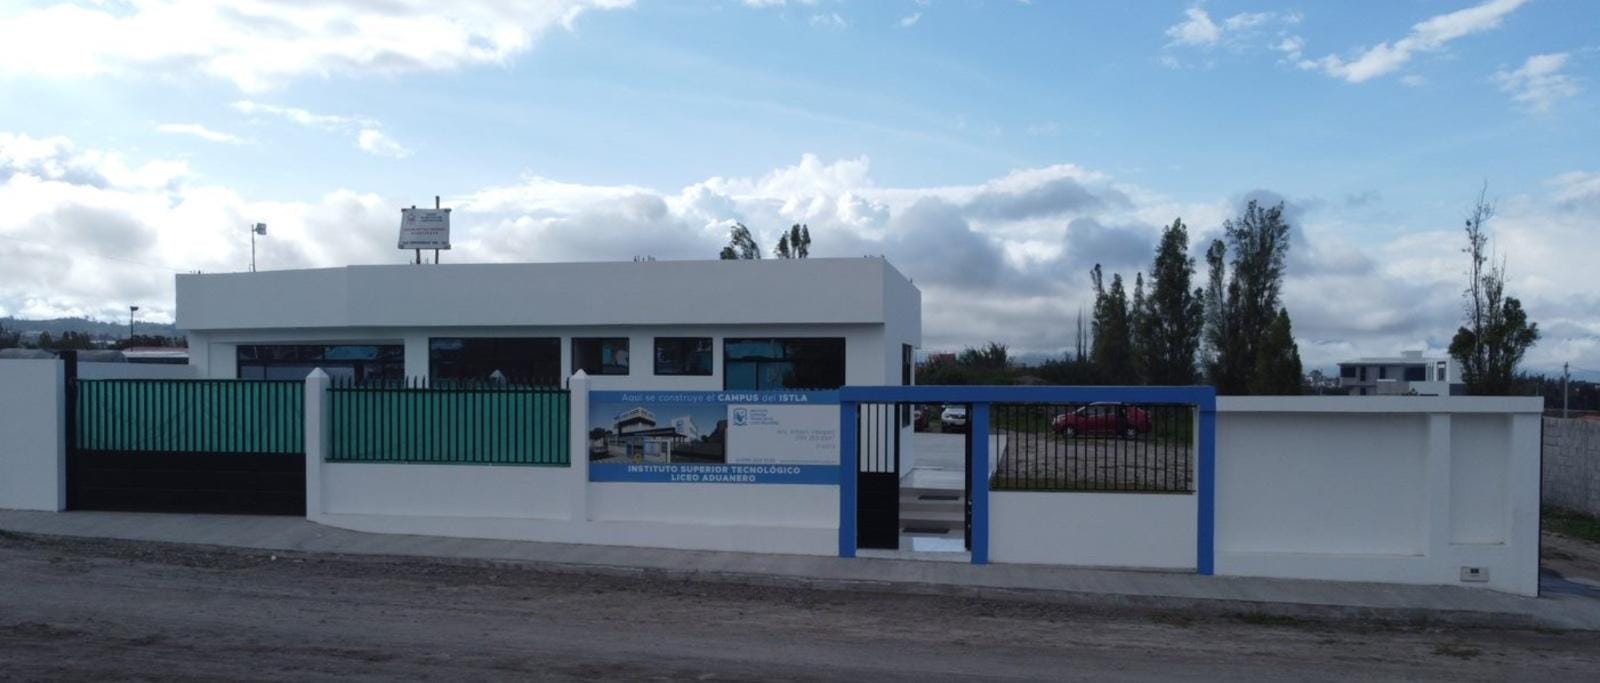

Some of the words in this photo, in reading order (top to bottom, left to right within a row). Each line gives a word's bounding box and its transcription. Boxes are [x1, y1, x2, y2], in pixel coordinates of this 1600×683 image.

[658, 394, 704, 403] construye
[718, 394, 758, 402] CAMPUS
[762, 393, 777, 402] del
[780, 394, 807, 402] ISTLA
[628, 465, 678, 473] INSTITUTO
[680, 465, 729, 473] SUPERIOR
[731, 465, 801, 474] TECNOLÓGICO
[702, 474, 756, 482] ADUANERO
